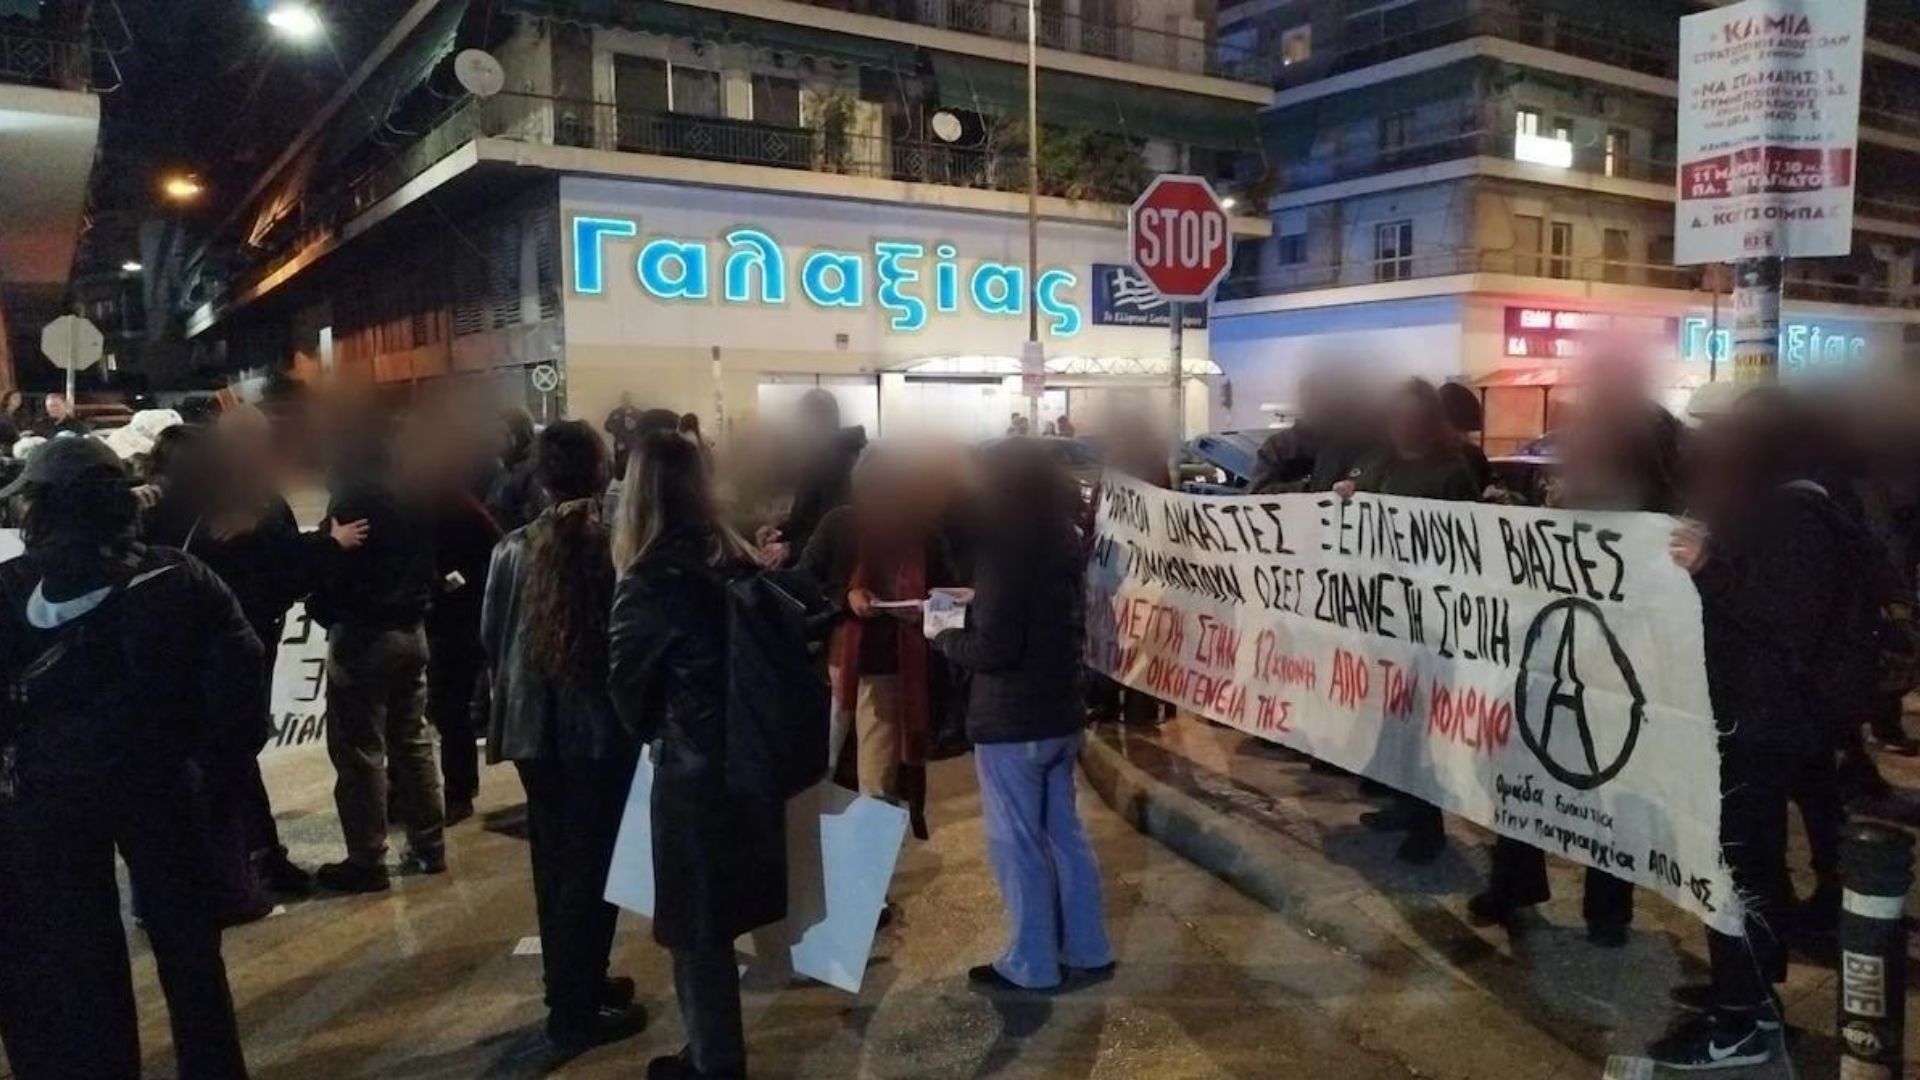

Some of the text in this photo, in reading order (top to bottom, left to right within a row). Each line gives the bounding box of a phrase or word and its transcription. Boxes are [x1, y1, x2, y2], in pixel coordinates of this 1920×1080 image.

[1140, 207, 1222, 269] STOP
[1164, 500, 1296, 555] ΔΙΚΑΣΤΕΣ
[1317, 499, 1482, 577] ΞΕΠΛΕΝΟΥΝ
[1499, 516, 1625, 602] ΒΙΑΣΤΕΣ
[1315, 568, 1397, 638] ΣΠΑΝΕ
[1195, 614, 1242, 669] ΣΤΗΝ
[1328, 647, 1369, 710] ΑΠΟ
[1258, 694, 1293, 733] ΤΗΣ
[1846, 955, 1882, 1014] BNE
